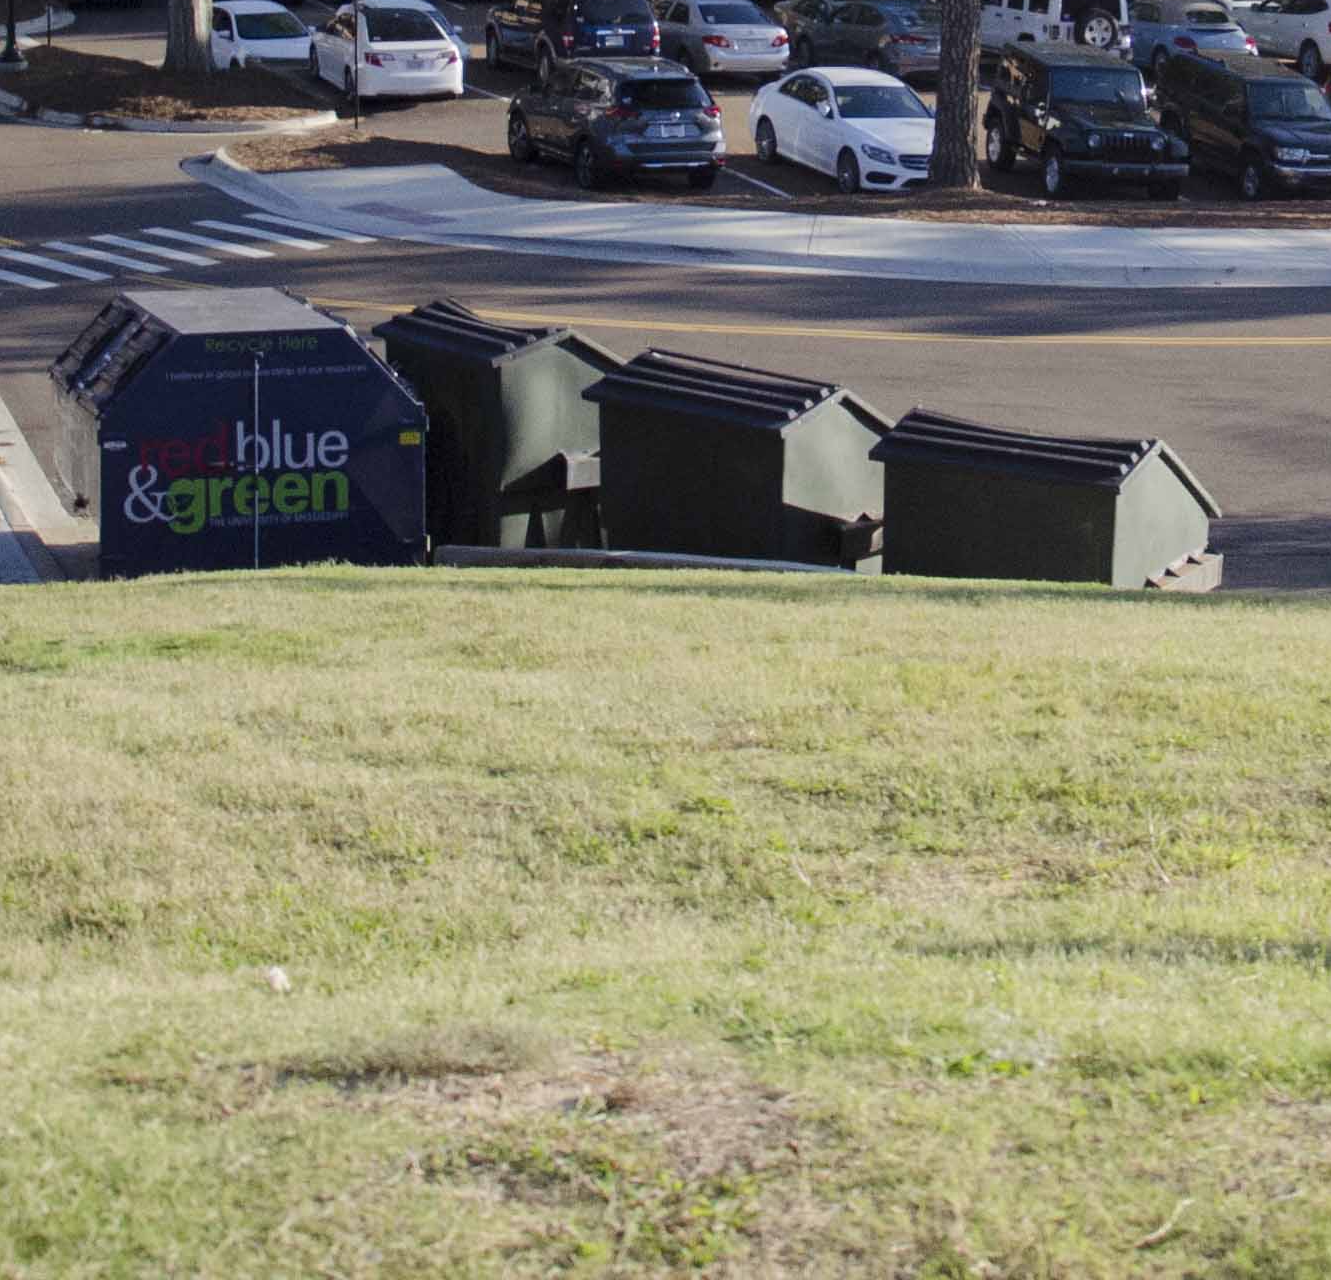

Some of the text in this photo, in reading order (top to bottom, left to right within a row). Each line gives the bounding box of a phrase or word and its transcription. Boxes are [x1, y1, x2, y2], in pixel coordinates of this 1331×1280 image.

[205, 334, 318, 354] Recycle Here
[236, 418, 349, 471] blue
